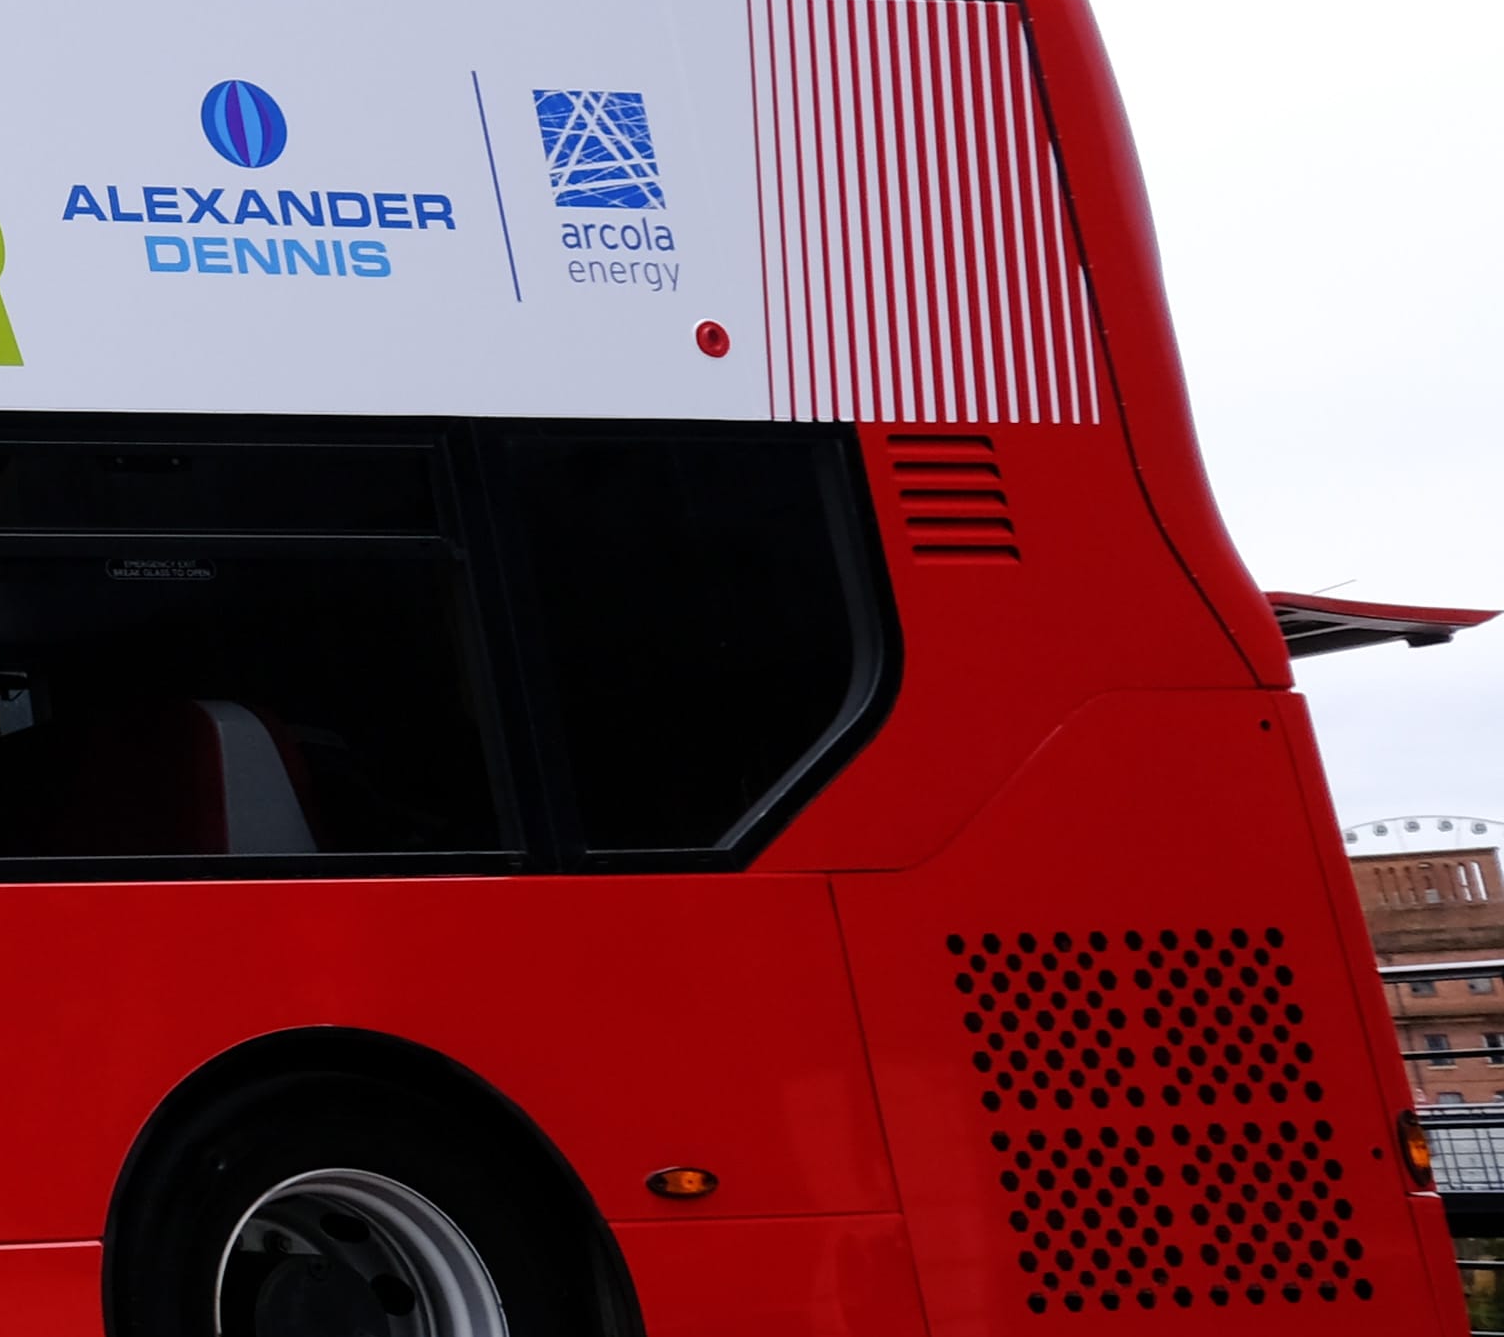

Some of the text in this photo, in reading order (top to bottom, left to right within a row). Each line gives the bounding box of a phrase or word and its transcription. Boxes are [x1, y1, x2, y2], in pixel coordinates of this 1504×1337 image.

[61, 184, 456, 231] ALEXANDER
[561, 216, 675, 253] arcola
[144, 234, 392, 278] DENNIS
[567, 256, 680, 292] energy
